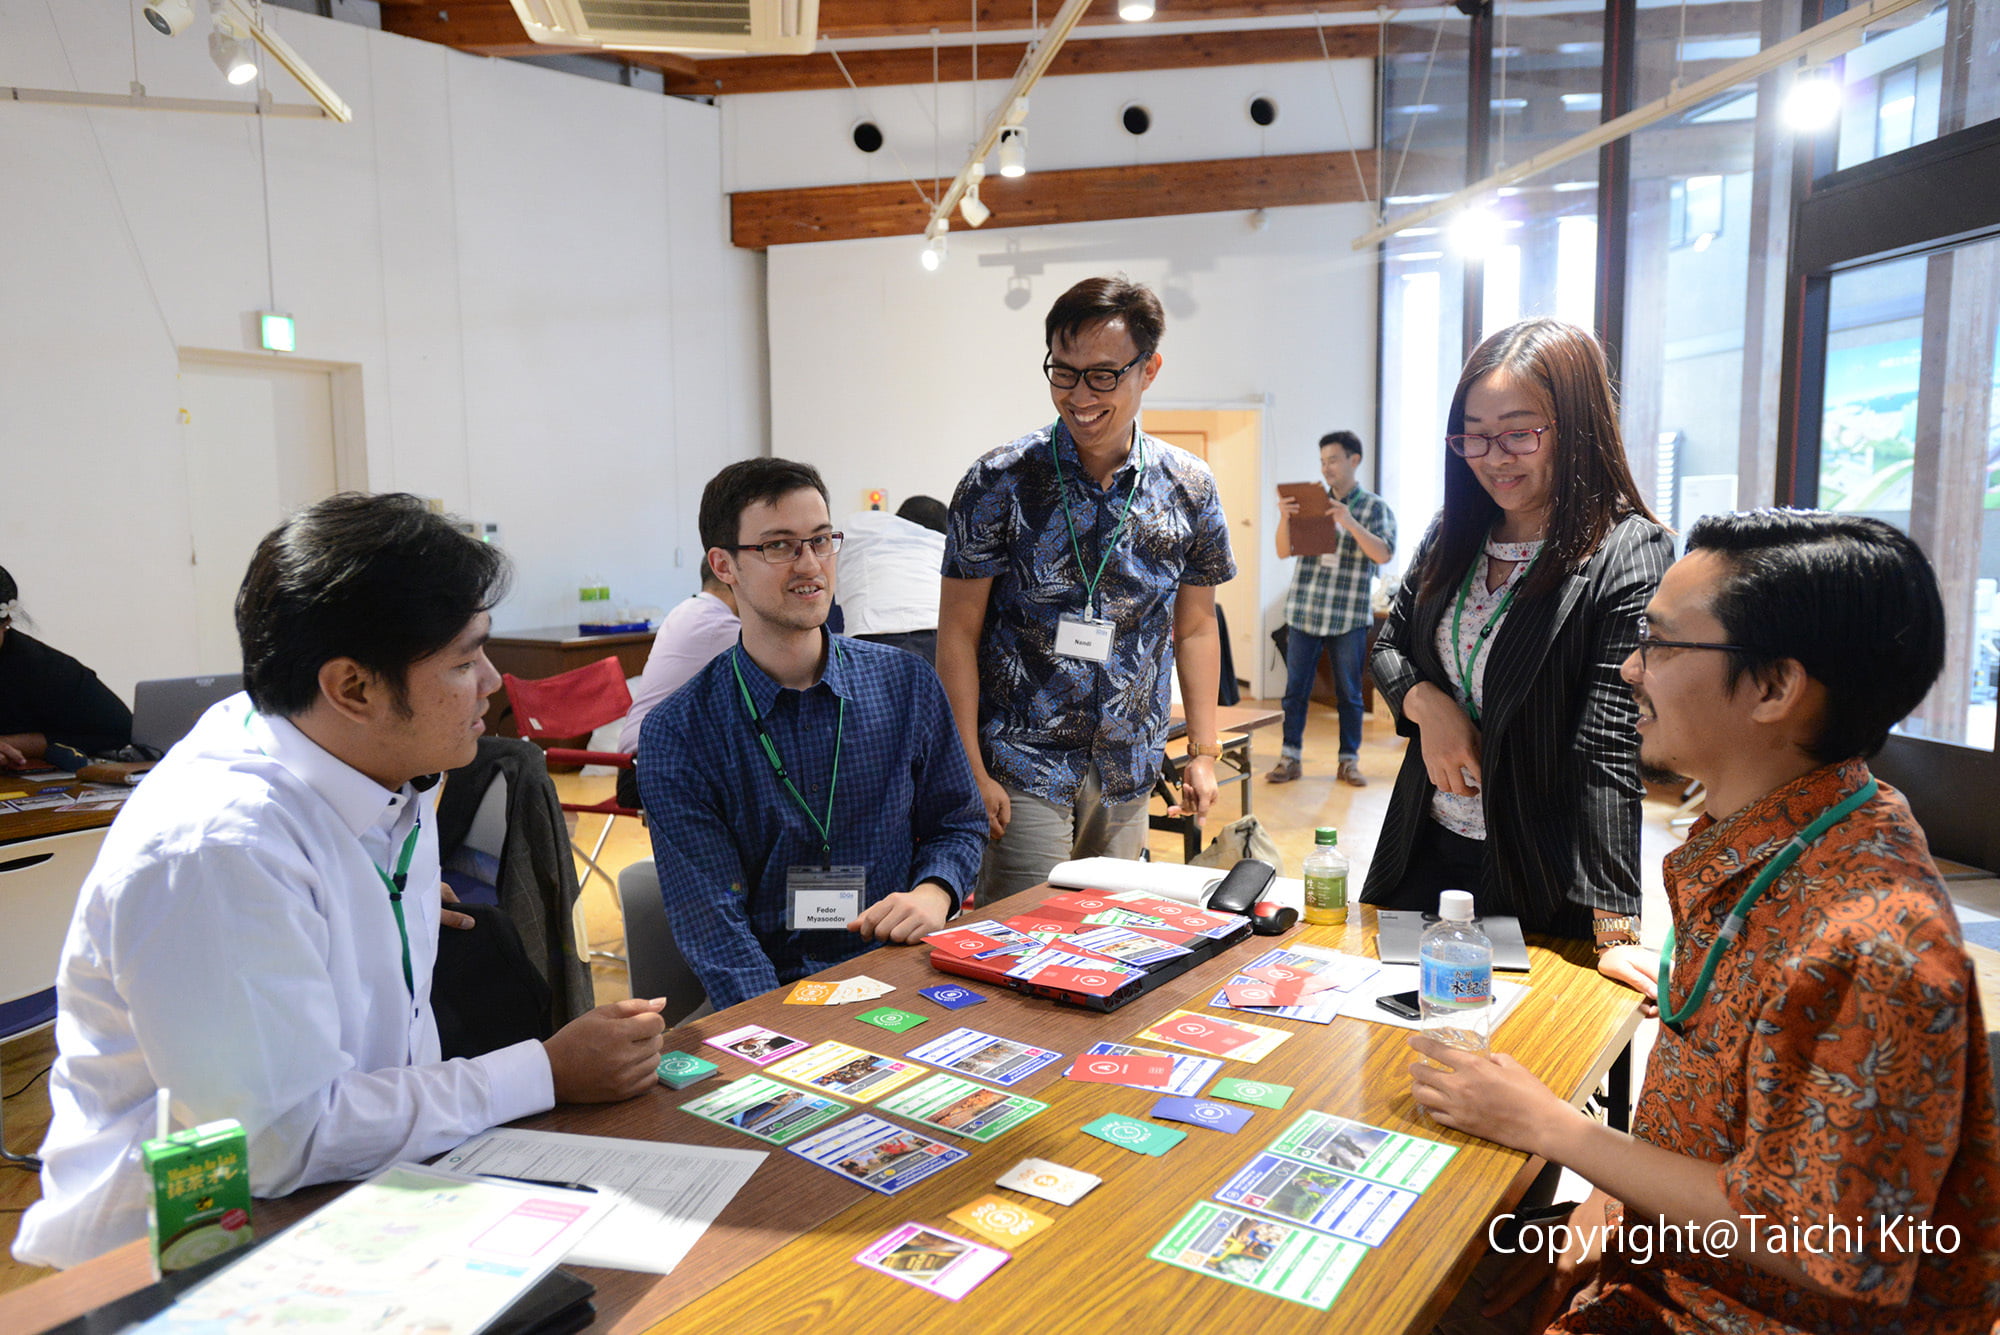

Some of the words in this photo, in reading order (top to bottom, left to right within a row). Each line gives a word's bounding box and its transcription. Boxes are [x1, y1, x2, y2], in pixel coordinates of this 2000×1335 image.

[1074, 639, 1092, 647] Nandi
[816, 906, 837, 914] Fedor
[806, 915, 846, 923] Myasoedov
